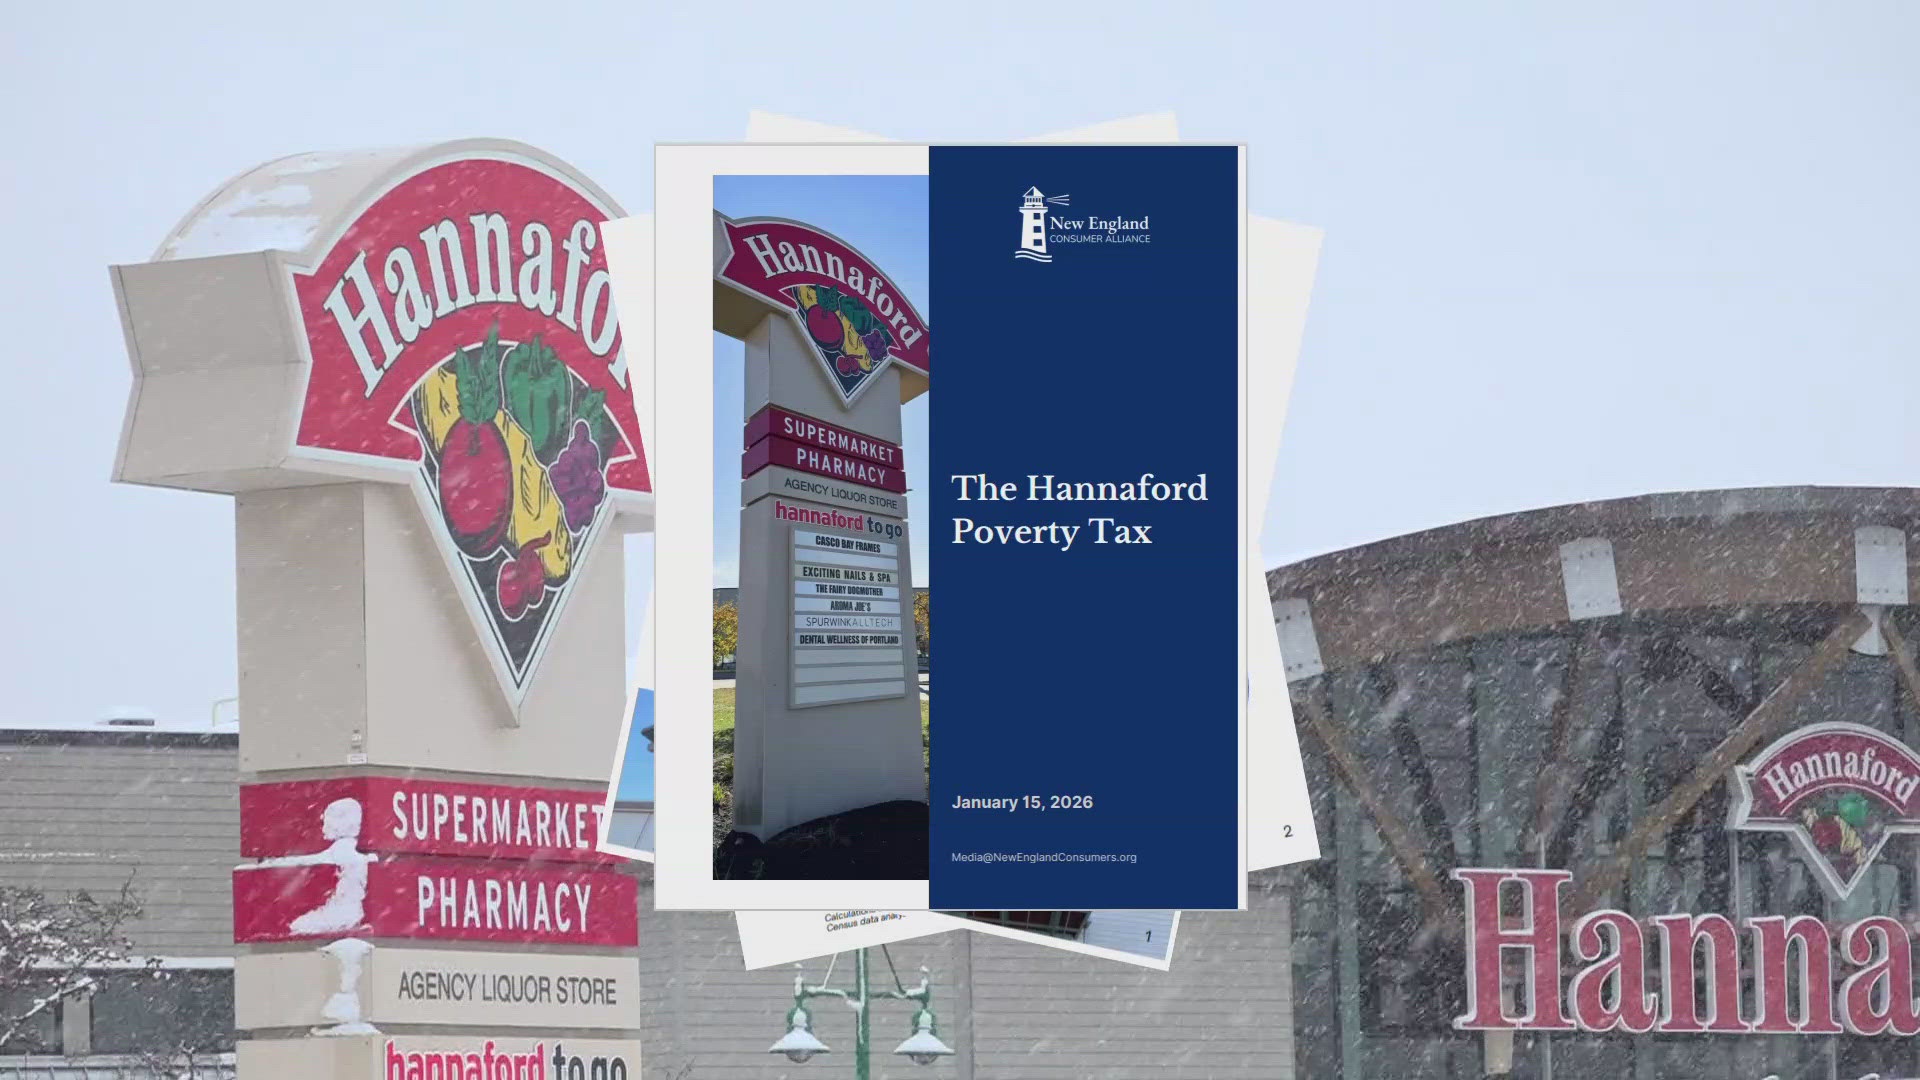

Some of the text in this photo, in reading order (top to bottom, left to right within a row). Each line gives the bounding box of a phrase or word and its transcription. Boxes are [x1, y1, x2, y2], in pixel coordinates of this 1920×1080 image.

[1050, 216, 1149, 234] New England
[1050, 234, 1151, 243] CONSUMER ALLIANCE
[743, 233, 923, 350] Hannaford
[323, 212, 628, 399] Hannafo
[784, 416, 894, 463] SUPERMARKET
[797, 447, 886, 485] PHARMACY
[784, 477, 898, 510] AGENCY LIQUOR STORE
[951, 473, 1208, 501] The Hannaford
[775, 500, 903, 540] hannaford to go
[815, 535, 880, 553] CASCO BAY FRAMES
[952, 518, 1153, 551] Poverty Tax
[803, 566, 891, 583] EXCITING NAILS & SPA
[815, 583, 884, 597] THE FAIRY DOGMOTHER
[830, 600, 853, 612] AROMA
[800, 634, 899, 645] DENTAL WELLNESS OF PORTLAND
[1762, 747, 1920, 806] Hannaford
[951, 795, 1094, 812] January 15, 2026
[1283, 825, 1294, 838] 2
[951, 852, 1137, 864] Media@NewEnglandConsumers.org
[417, 875, 592, 934] PHARMACY
[826, 920, 858, 932] Census
[860, 916, 879, 925] data
[1145, 930, 1152, 942] 1
[1451, 868, 1920, 1037] Hanna
[398, 971, 617, 1006] AGENCY LIQUOR STORE
